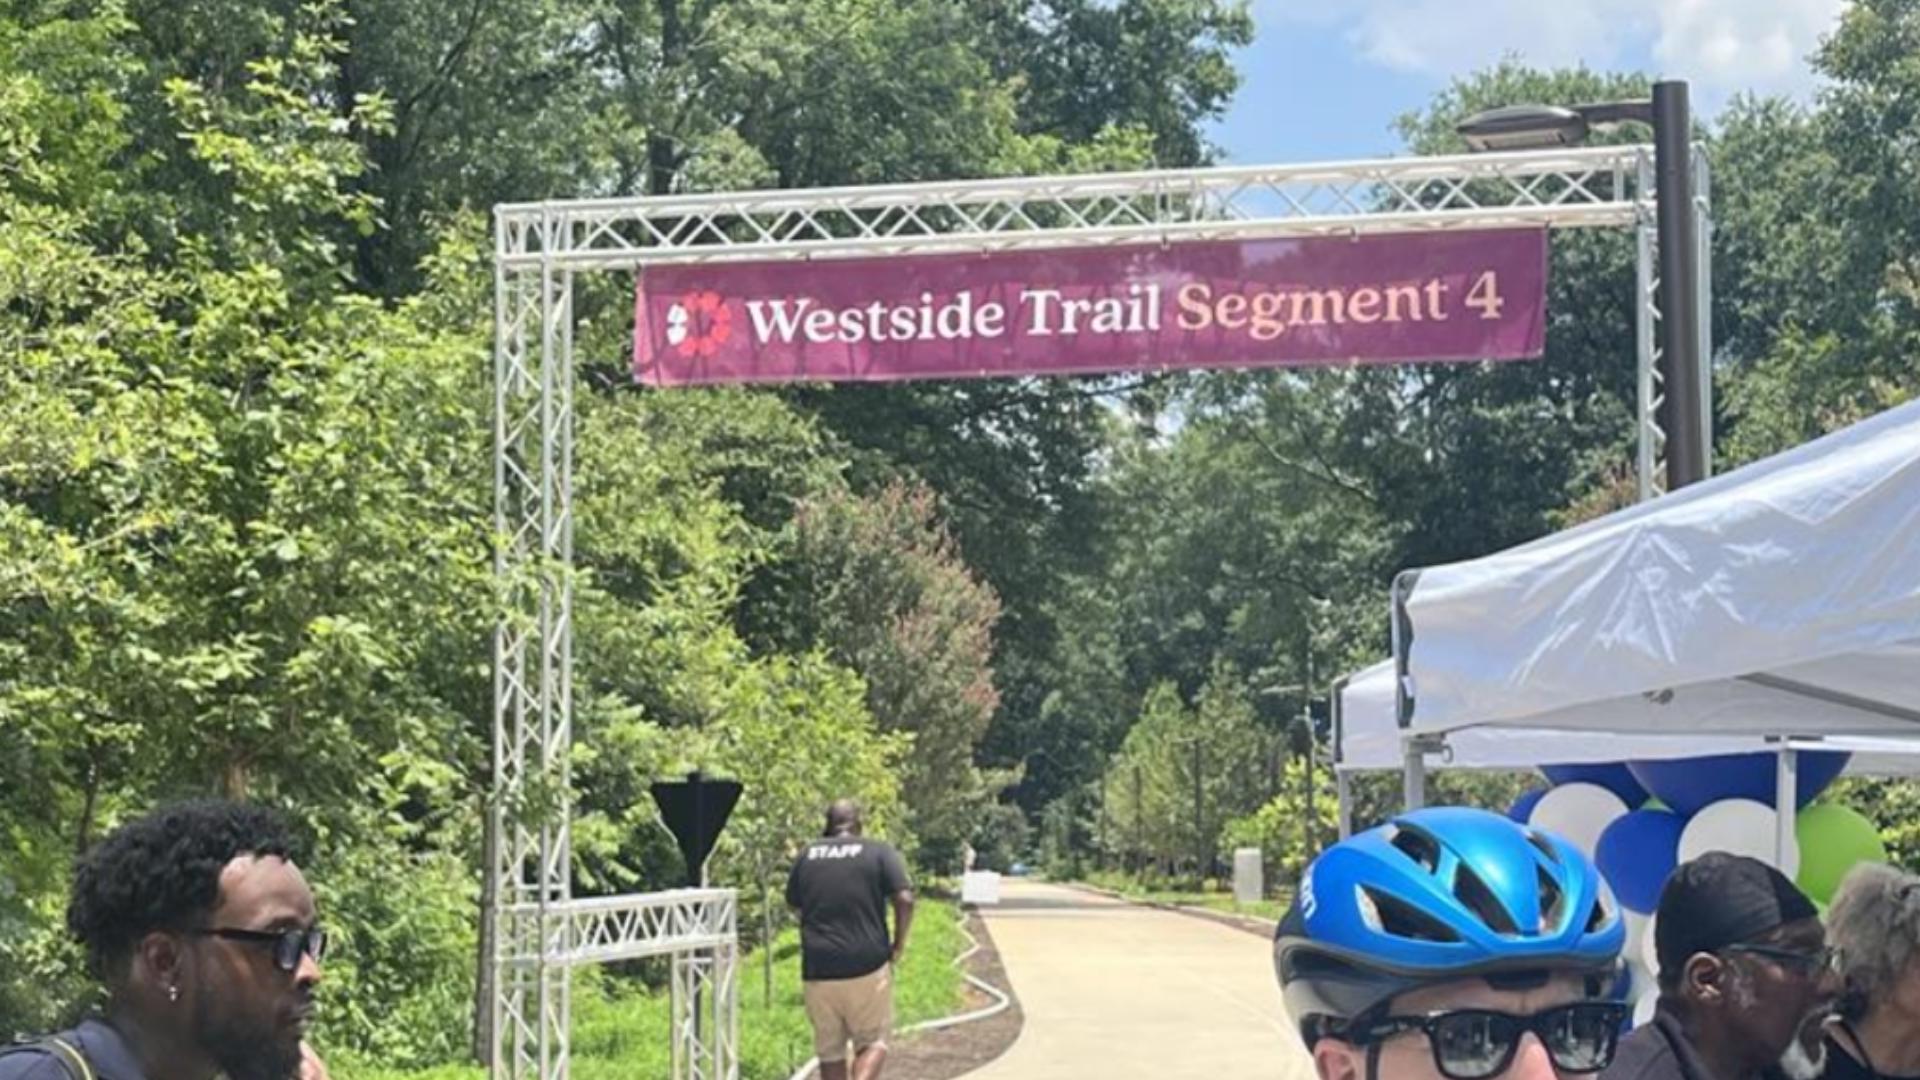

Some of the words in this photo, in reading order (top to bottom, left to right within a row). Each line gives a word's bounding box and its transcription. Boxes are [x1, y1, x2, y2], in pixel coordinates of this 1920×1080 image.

[746, 290, 1005, 344] Westside
[1019, 283, 1161, 336] Trail
[1176, 279, 1449, 341] Segment
[1464, 270, 1505, 321] 4
[807, 843, 863, 860] STAFF
